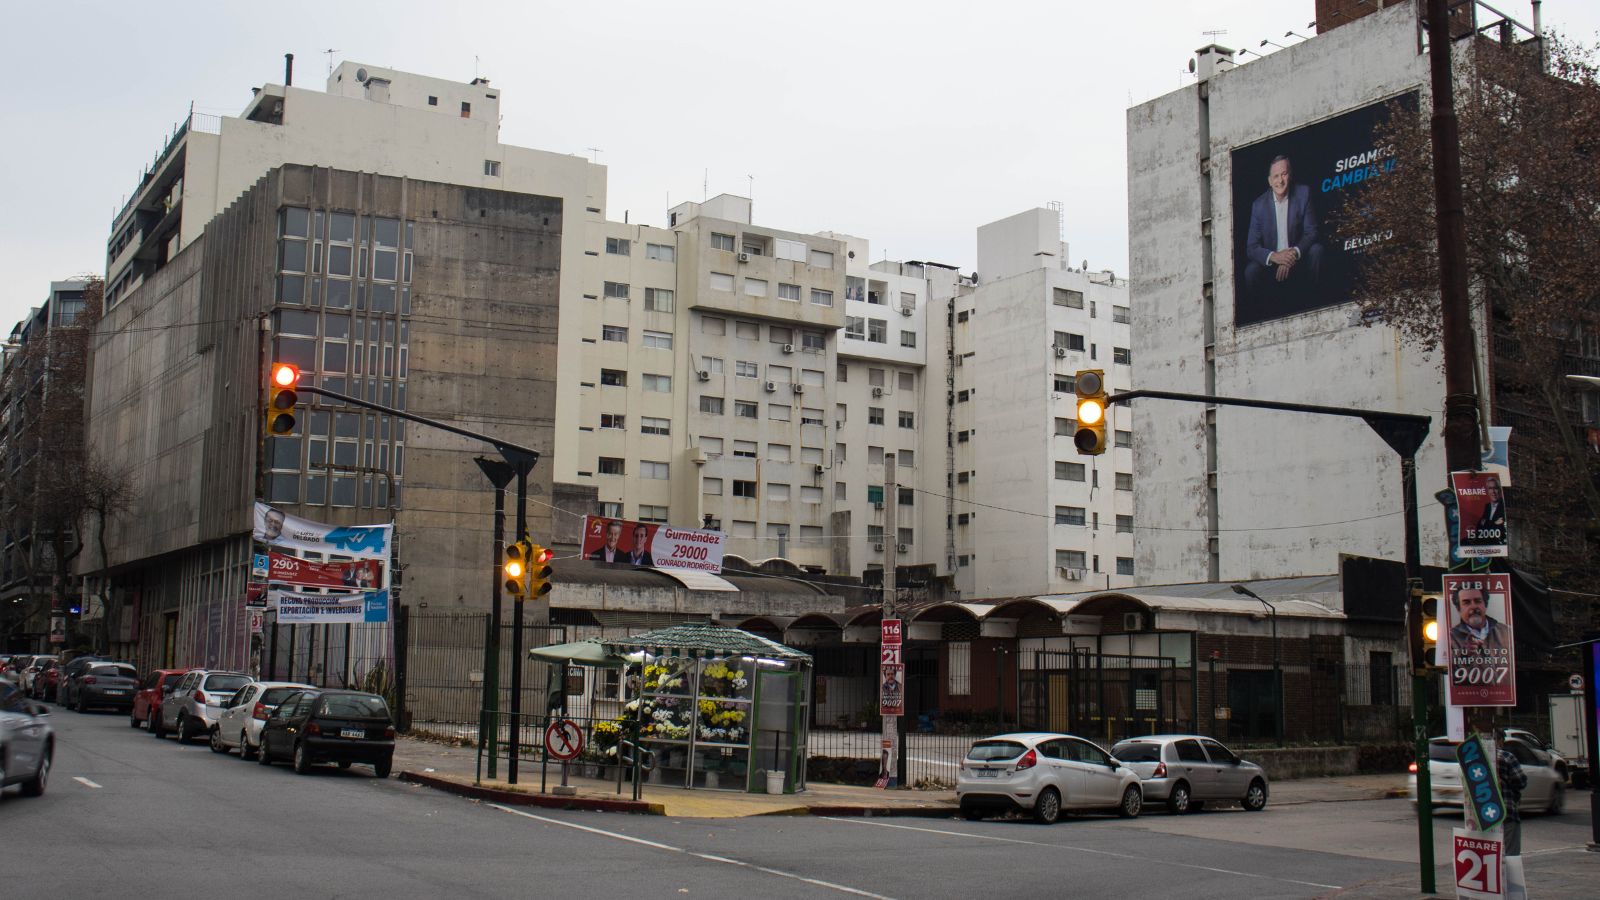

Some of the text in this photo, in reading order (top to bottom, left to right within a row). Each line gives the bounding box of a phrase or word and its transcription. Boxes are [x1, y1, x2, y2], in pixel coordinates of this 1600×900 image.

[1458, 487, 1487, 496] TABARÉ
[292, 534, 320, 543] DELGADO
[665, 528, 720, 545] Gurméndez
[1466, 528, 1501, 539] 15 2000
[671, 544, 708, 561] 29000
[272, 558, 300, 571] 2901
[656, 558, 720, 572] CONRADO RODRÍGUEZ
[1449, 579, 1505, 591] ZUBÍA
[326, 606, 362, 614] INVERSIONES
[883, 625, 900, 635] 116
[882, 650, 900, 664] 21
[1453, 656, 1508, 665] IMPORTA
[1454, 667, 1508, 684] 9007
[1457, 838, 1498, 851] TABARÉ
[1457, 849, 1497, 893] 21
